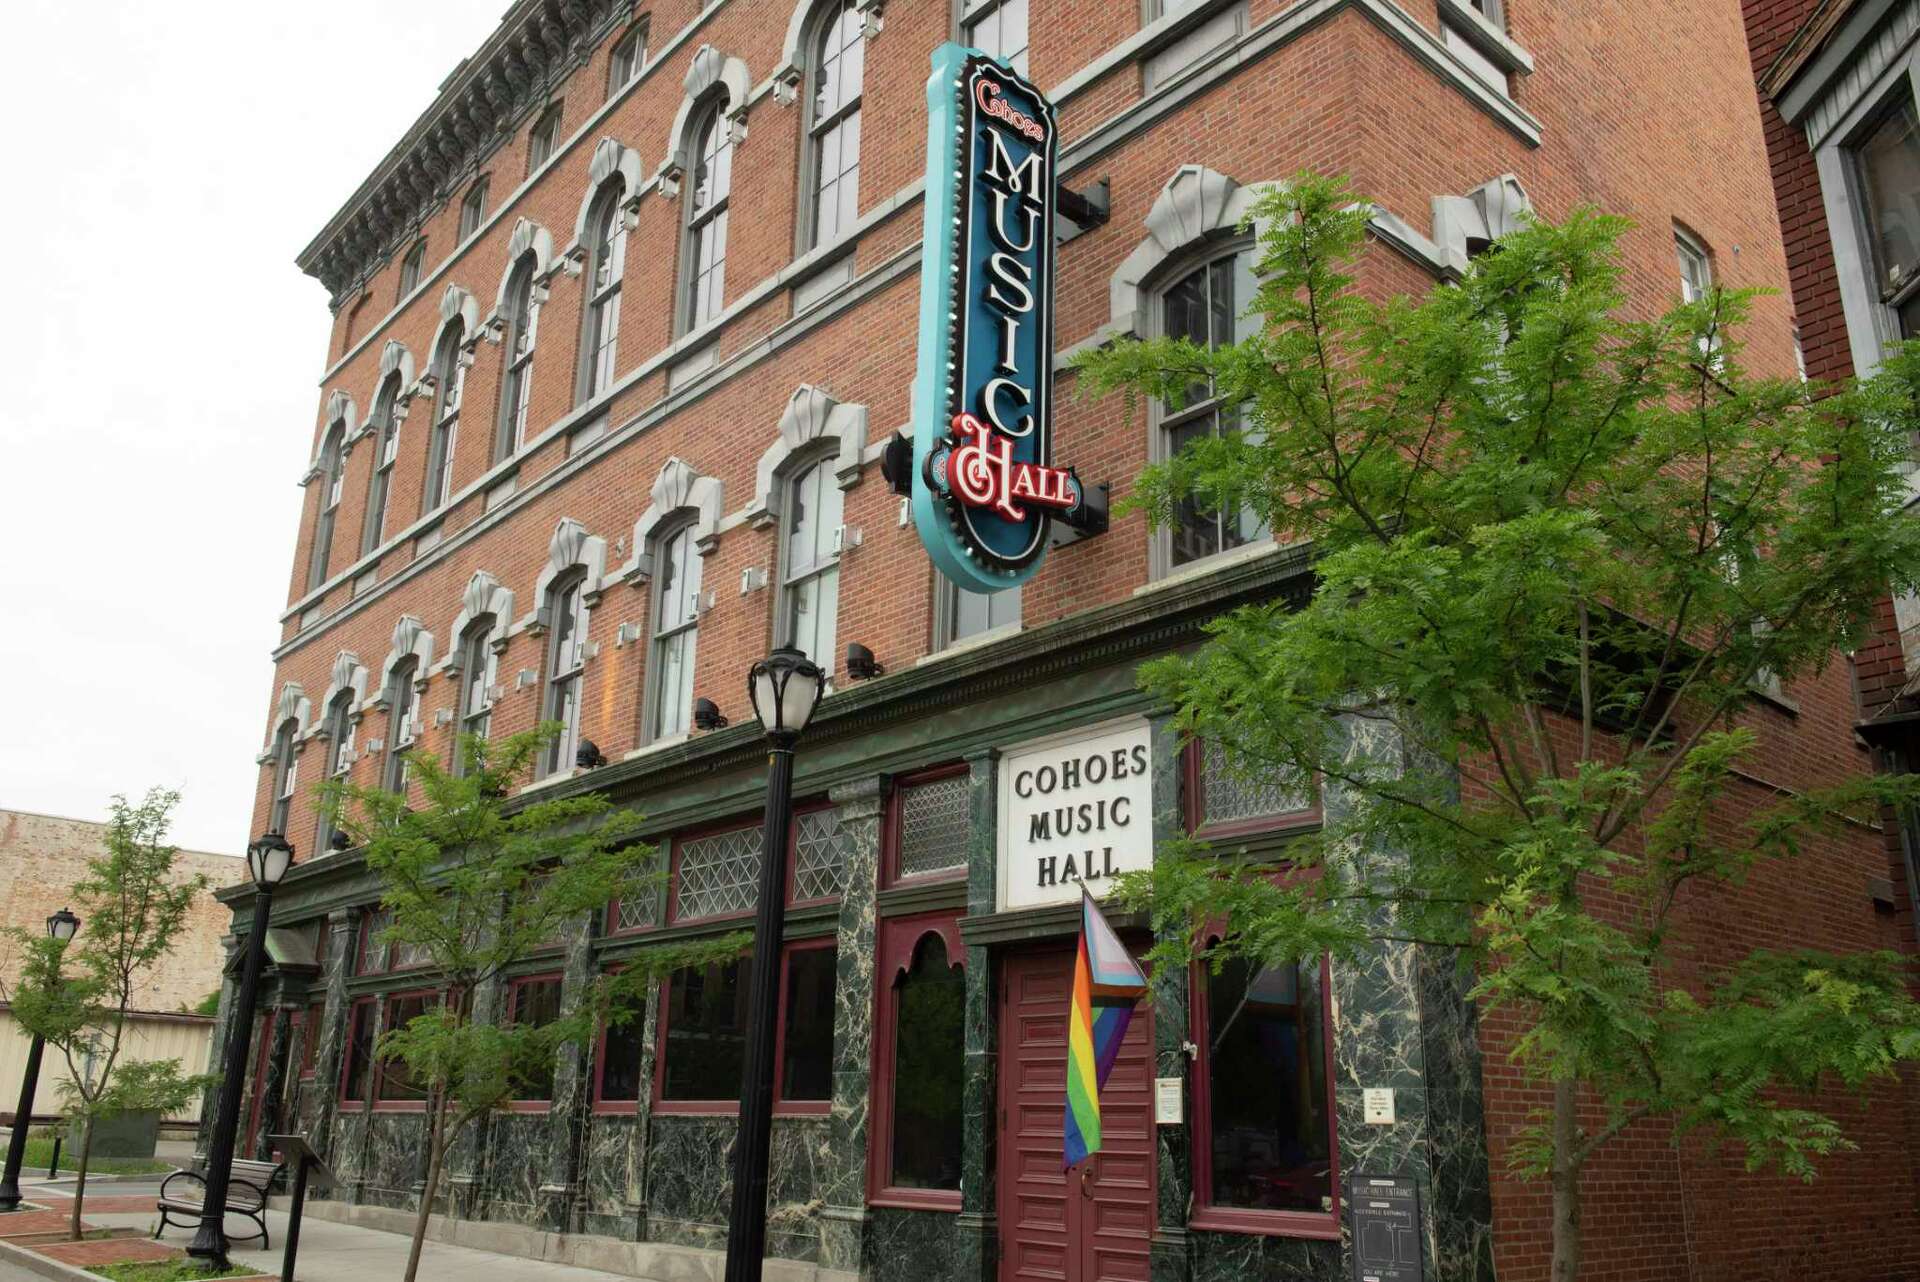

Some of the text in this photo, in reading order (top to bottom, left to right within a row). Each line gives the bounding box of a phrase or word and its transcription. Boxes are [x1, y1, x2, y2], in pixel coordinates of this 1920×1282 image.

[976, 79, 1044, 141] Cohoes
[984, 126, 1043, 437] MUSIC
[955, 412, 1075, 521] HALL
[1014, 744, 1147, 799] COHOES
[1028, 796, 1131, 844] MUSIC
[1037, 846, 1120, 887] HALL
